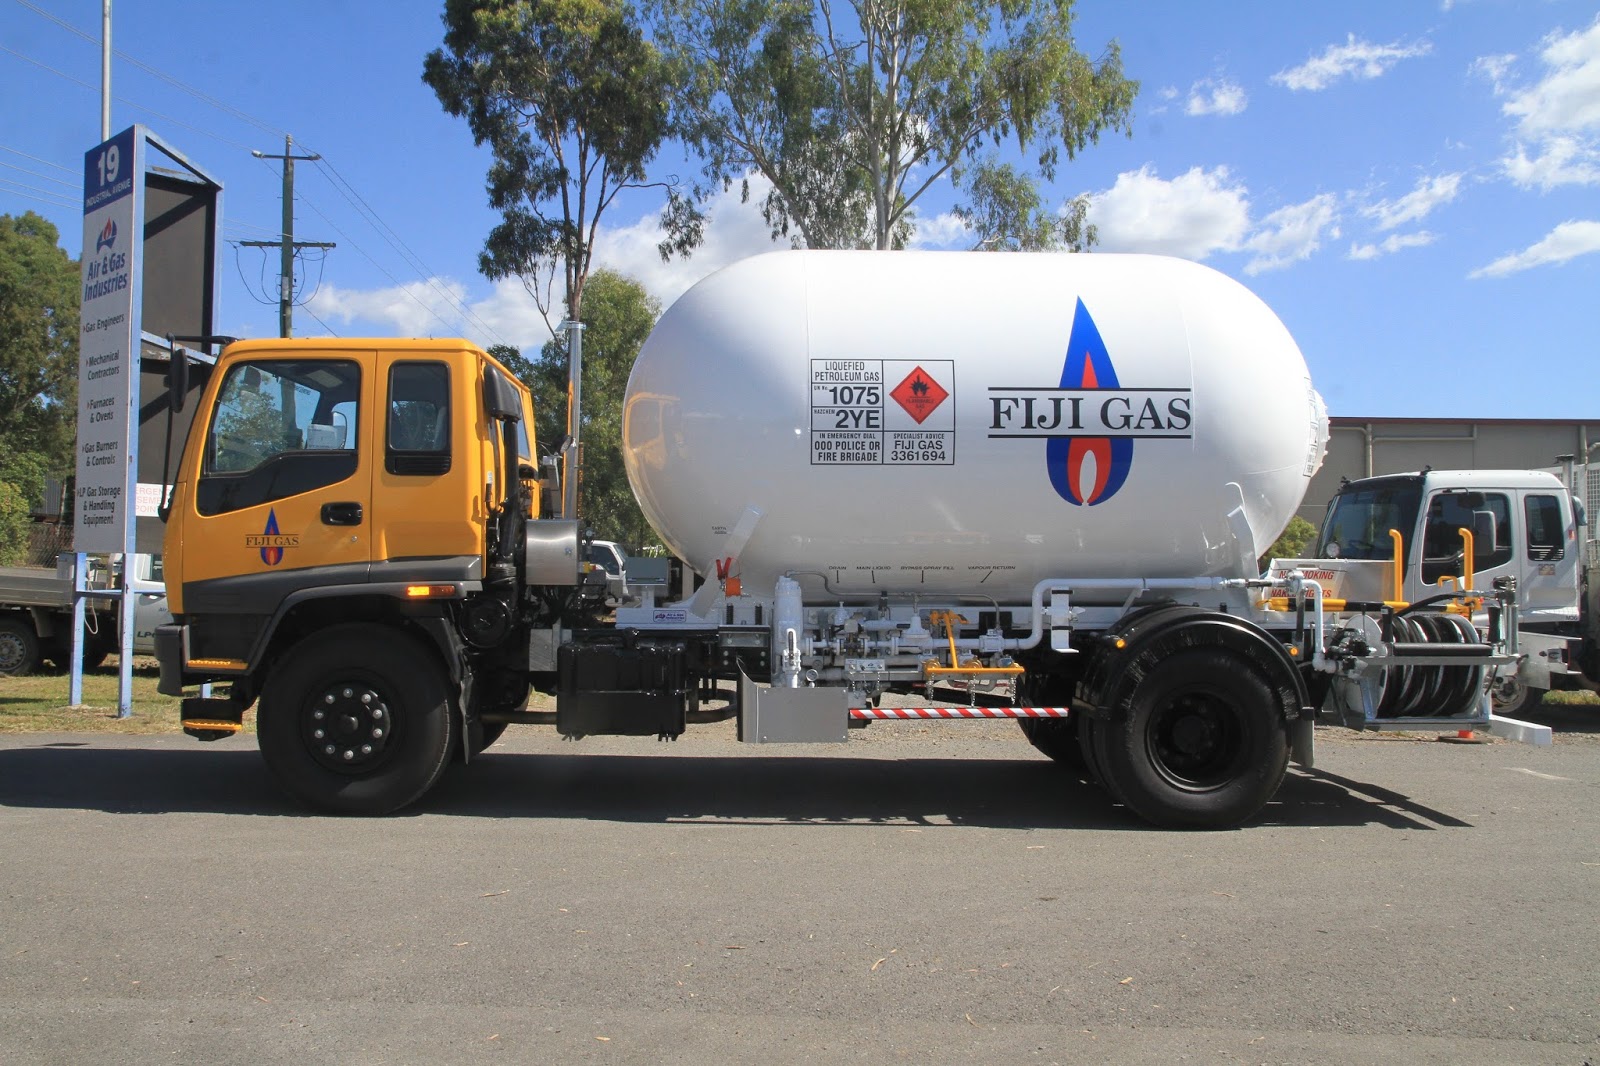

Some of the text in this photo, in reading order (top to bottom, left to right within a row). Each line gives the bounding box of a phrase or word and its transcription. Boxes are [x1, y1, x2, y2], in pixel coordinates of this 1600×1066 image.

[98, 145, 120, 186] 19
[112, 178, 131, 194] AVENUE
[88, 252, 126, 280] Air & Gas
[84, 272, 128, 302] Industries
[86, 314, 124, 332] Gas Engineers
[89, 350, 120, 367] Mechanical
[825, 361, 865, 371] LIQUEFIED
[88, 366, 120, 380] Contractors
[814, 372, 880, 382] PETROLEUM GAS
[829, 386, 880, 405] 1075
[90, 411, 114, 423] & Ovens
[836, 410, 880, 428] 2YE
[989, 398, 1191, 430] FIJI GAS
[84, 441, 118, 453] Gas Burners
[814, 441, 880, 450] 000 POLICE OR
[894, 441, 943, 450] FIJI GAS
[86, 454, 116, 467] & Controls
[818, 452, 878, 462] FIRE BRIGADE
[891, 451, 946, 461] 3361694
[87, 487, 97, 497] Gas
[98, 486, 121, 499] Storage
[83, 500, 115, 513] & Handling
[83, 514, 114, 528] Equipment
[246, 536, 299, 546] FIJI GAS
[1302, 571, 1334, 580] MOKING
